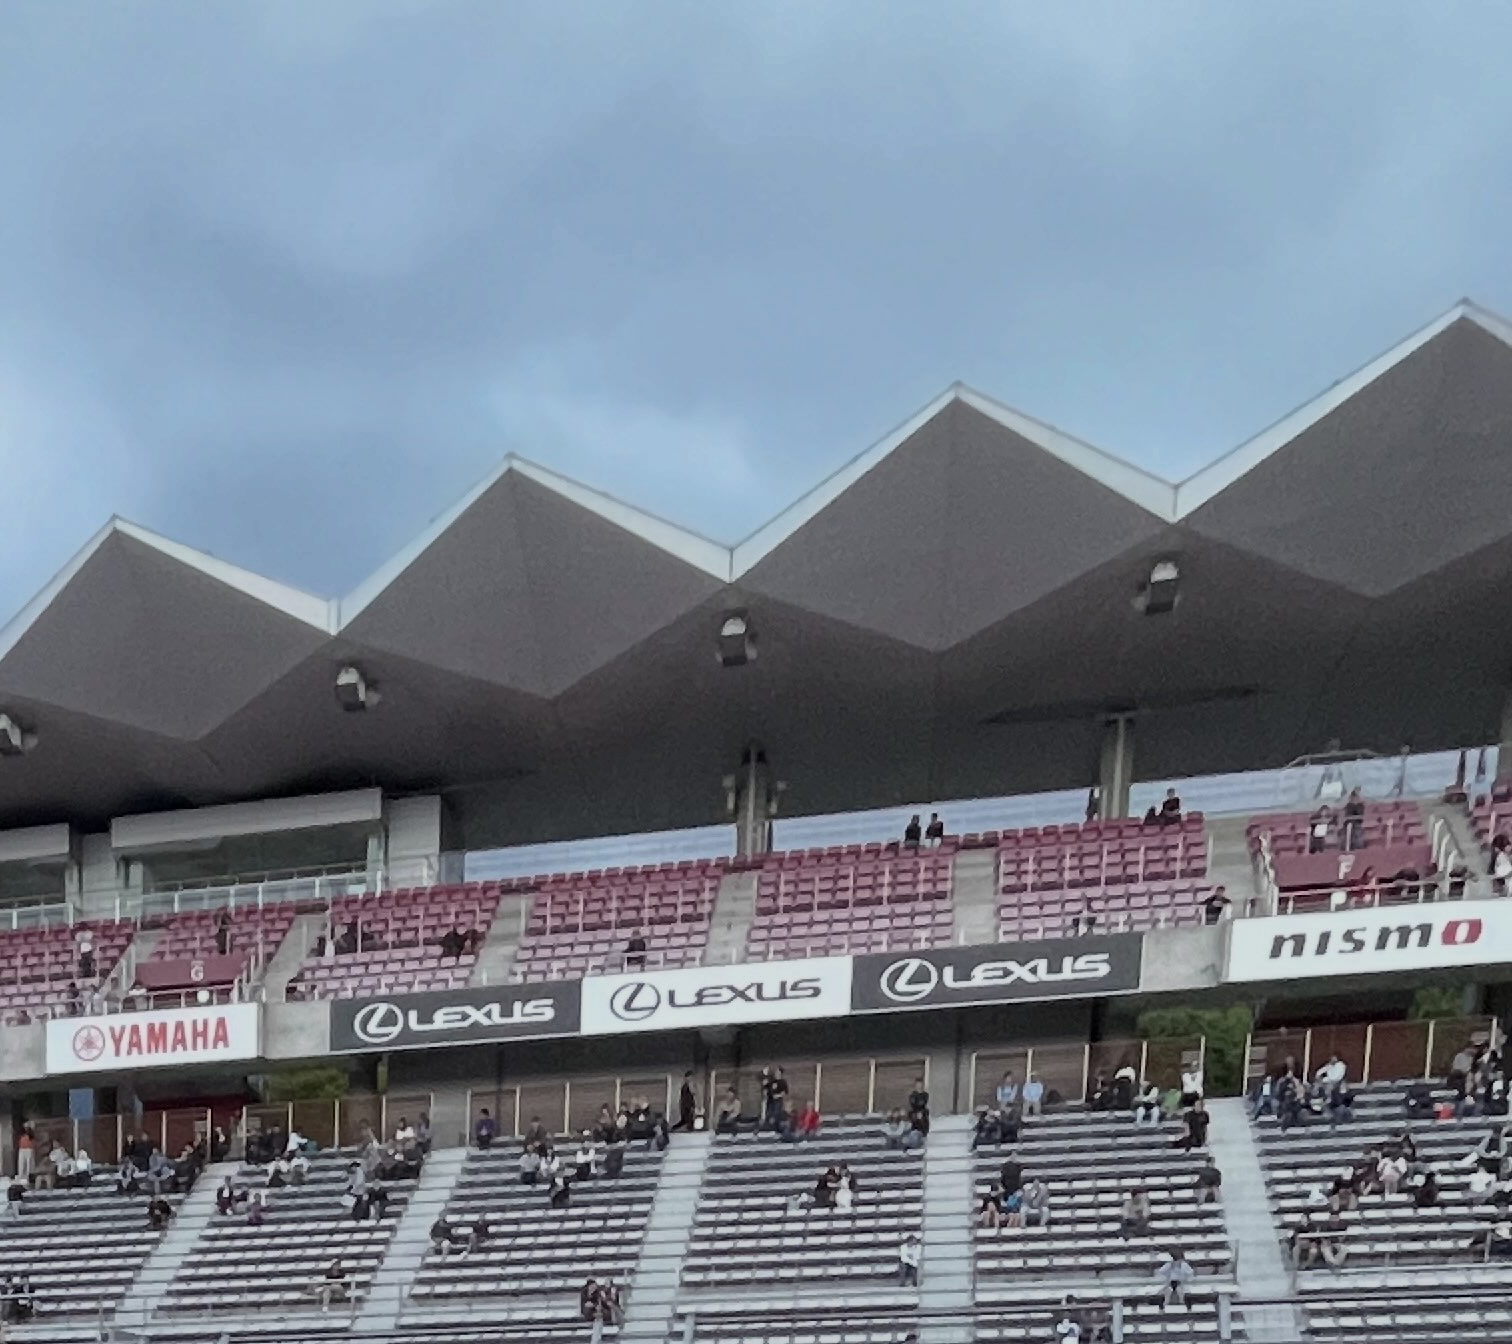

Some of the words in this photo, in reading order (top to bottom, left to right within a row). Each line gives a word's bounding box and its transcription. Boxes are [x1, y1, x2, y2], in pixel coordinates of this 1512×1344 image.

[943, 953, 1111, 989] LEXUS
[668, 978, 822, 1009] LEXUS
[407, 998, 555, 1032] LEXUS
[109, 1015, 230, 1058] YAMAHA
